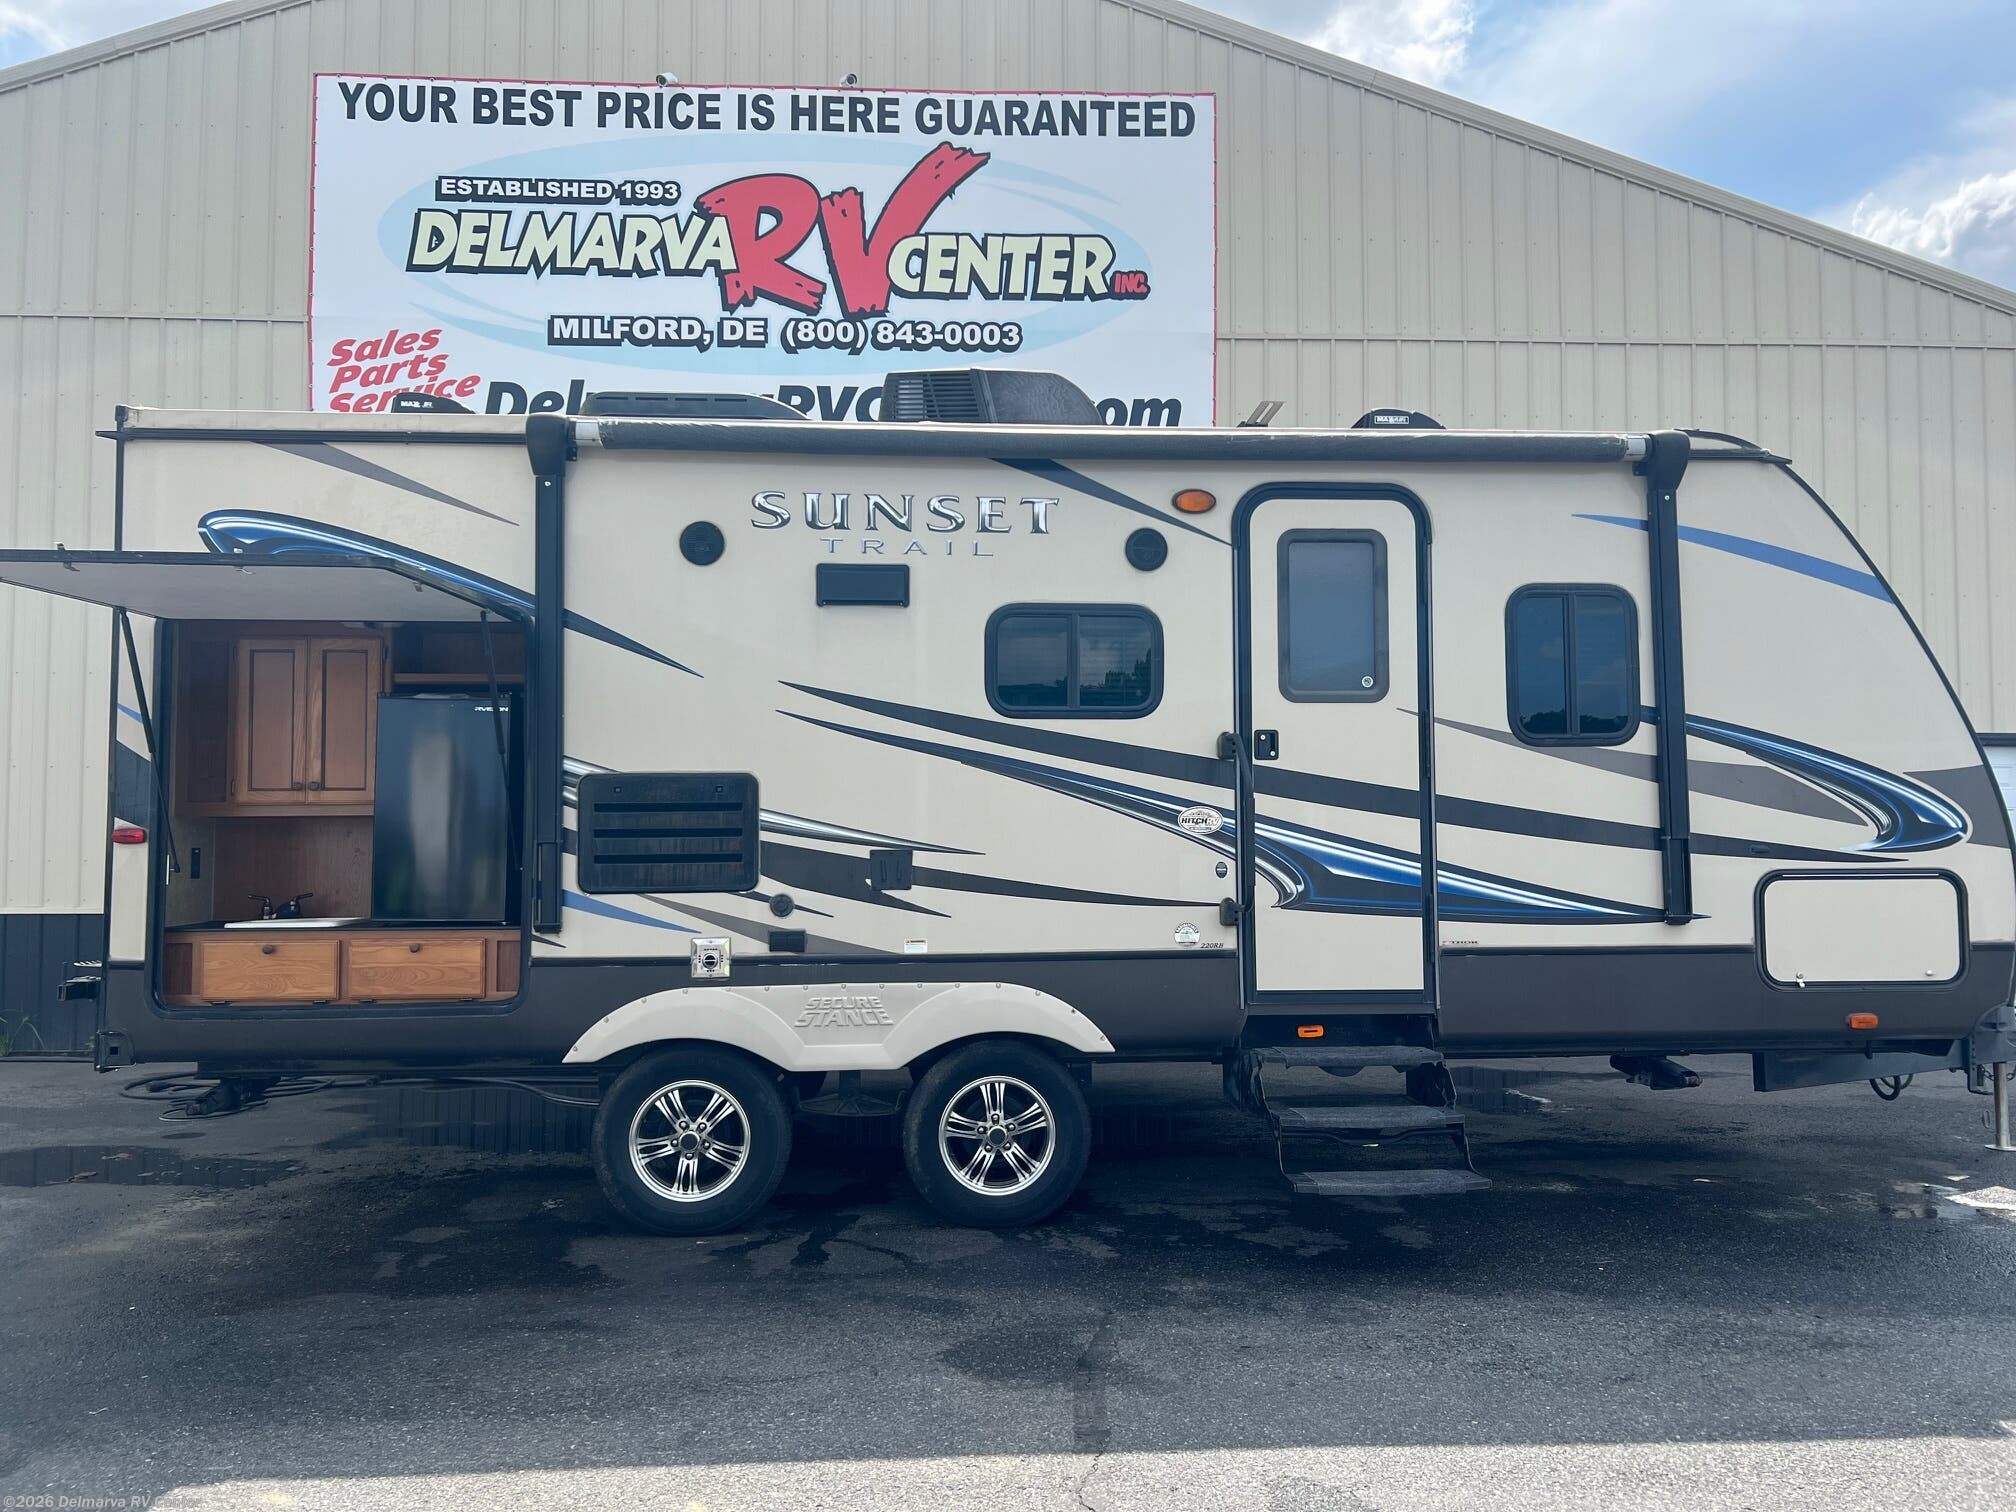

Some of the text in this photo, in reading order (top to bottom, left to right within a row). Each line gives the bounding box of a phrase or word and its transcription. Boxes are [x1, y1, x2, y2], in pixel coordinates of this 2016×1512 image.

[338, 82, 1196, 137] YOUR BEST PRICE IS HERE GUARANTEED
[438, 178, 680, 201] ESTABLISHED 1993
[408, 207, 740, 275] DELMARVA
[694, 141, 991, 318] RV
[887, 233, 1114, 298] CENTER
[327, 328, 443, 367] Sales
[551, 316, 1021, 355] MILFORD, DE (800) 843-0003
[329, 353, 449, 394] Parts
[750, 490, 1061, 535] SUNSET
[820, 537, 995, 557] TRAIL
[794, 1008, 895, 1028] STANCE
[804, 996, 884, 1010] SECURE
